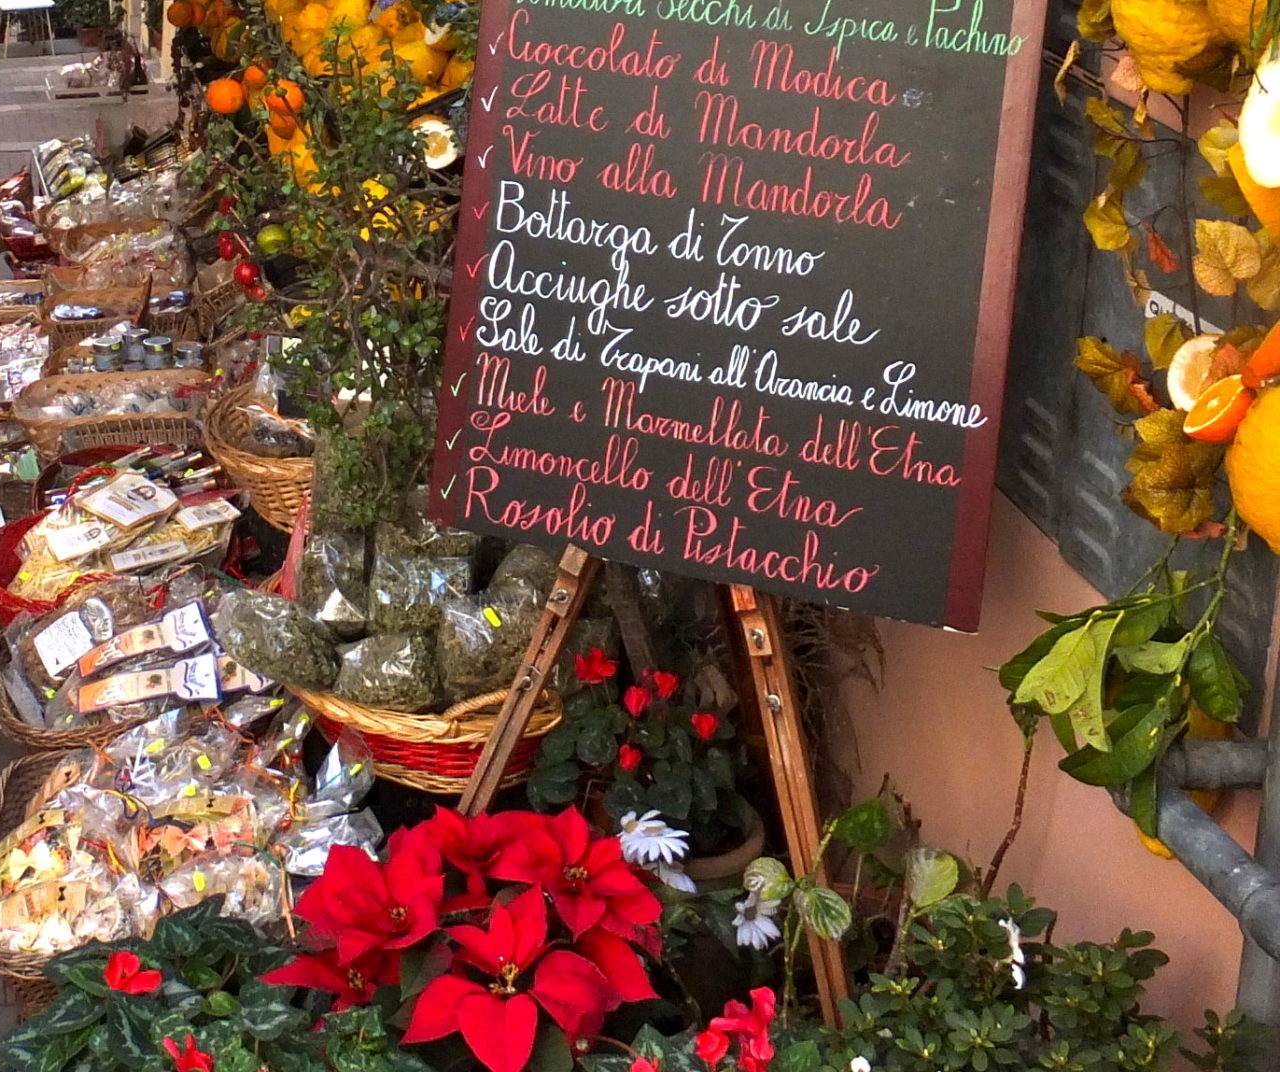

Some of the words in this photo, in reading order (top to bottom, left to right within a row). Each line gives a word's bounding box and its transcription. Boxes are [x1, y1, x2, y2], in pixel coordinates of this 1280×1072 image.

[508, 8, 682, 79] Cioccolato
[694, 35, 729, 86] di
[749, 39, 897, 107] Modica
[904, 24, 918, 45] e
[506, 69, 609, 132] Latte
[625, 85, 671, 138] di
[694, 90, 912, 168] Mandorla
[503, 124, 584, 183] Vino
[597, 142, 677, 198] alla
[697, 152, 904, 229] Mandorla
[496, 180, 658, 271] Bottarga
[668, 208, 704, 262] di
[717, 213, 826, 276] Tonno
[488, 240, 655, 335] Acciughe
[664, 272, 780, 331] sotto
[782, 289, 882, 344] sale
[476, 296, 543, 355] Sale
[550, 316, 586, 362] di
[601, 319, 703, 393] Trapani
[861, 387, 875, 410] e
[880, 360, 989, 428] Limone
[476, 351, 556, 416] Miele
[568, 401, 587, 422] e
[601, 376, 789, 457] Marmellata
[469, 410, 654, 490] Limoncello
[465, 465, 616, 545] Rosolio
[627, 500, 664, 554] di
[673, 505, 880, 593] Pistacchio
